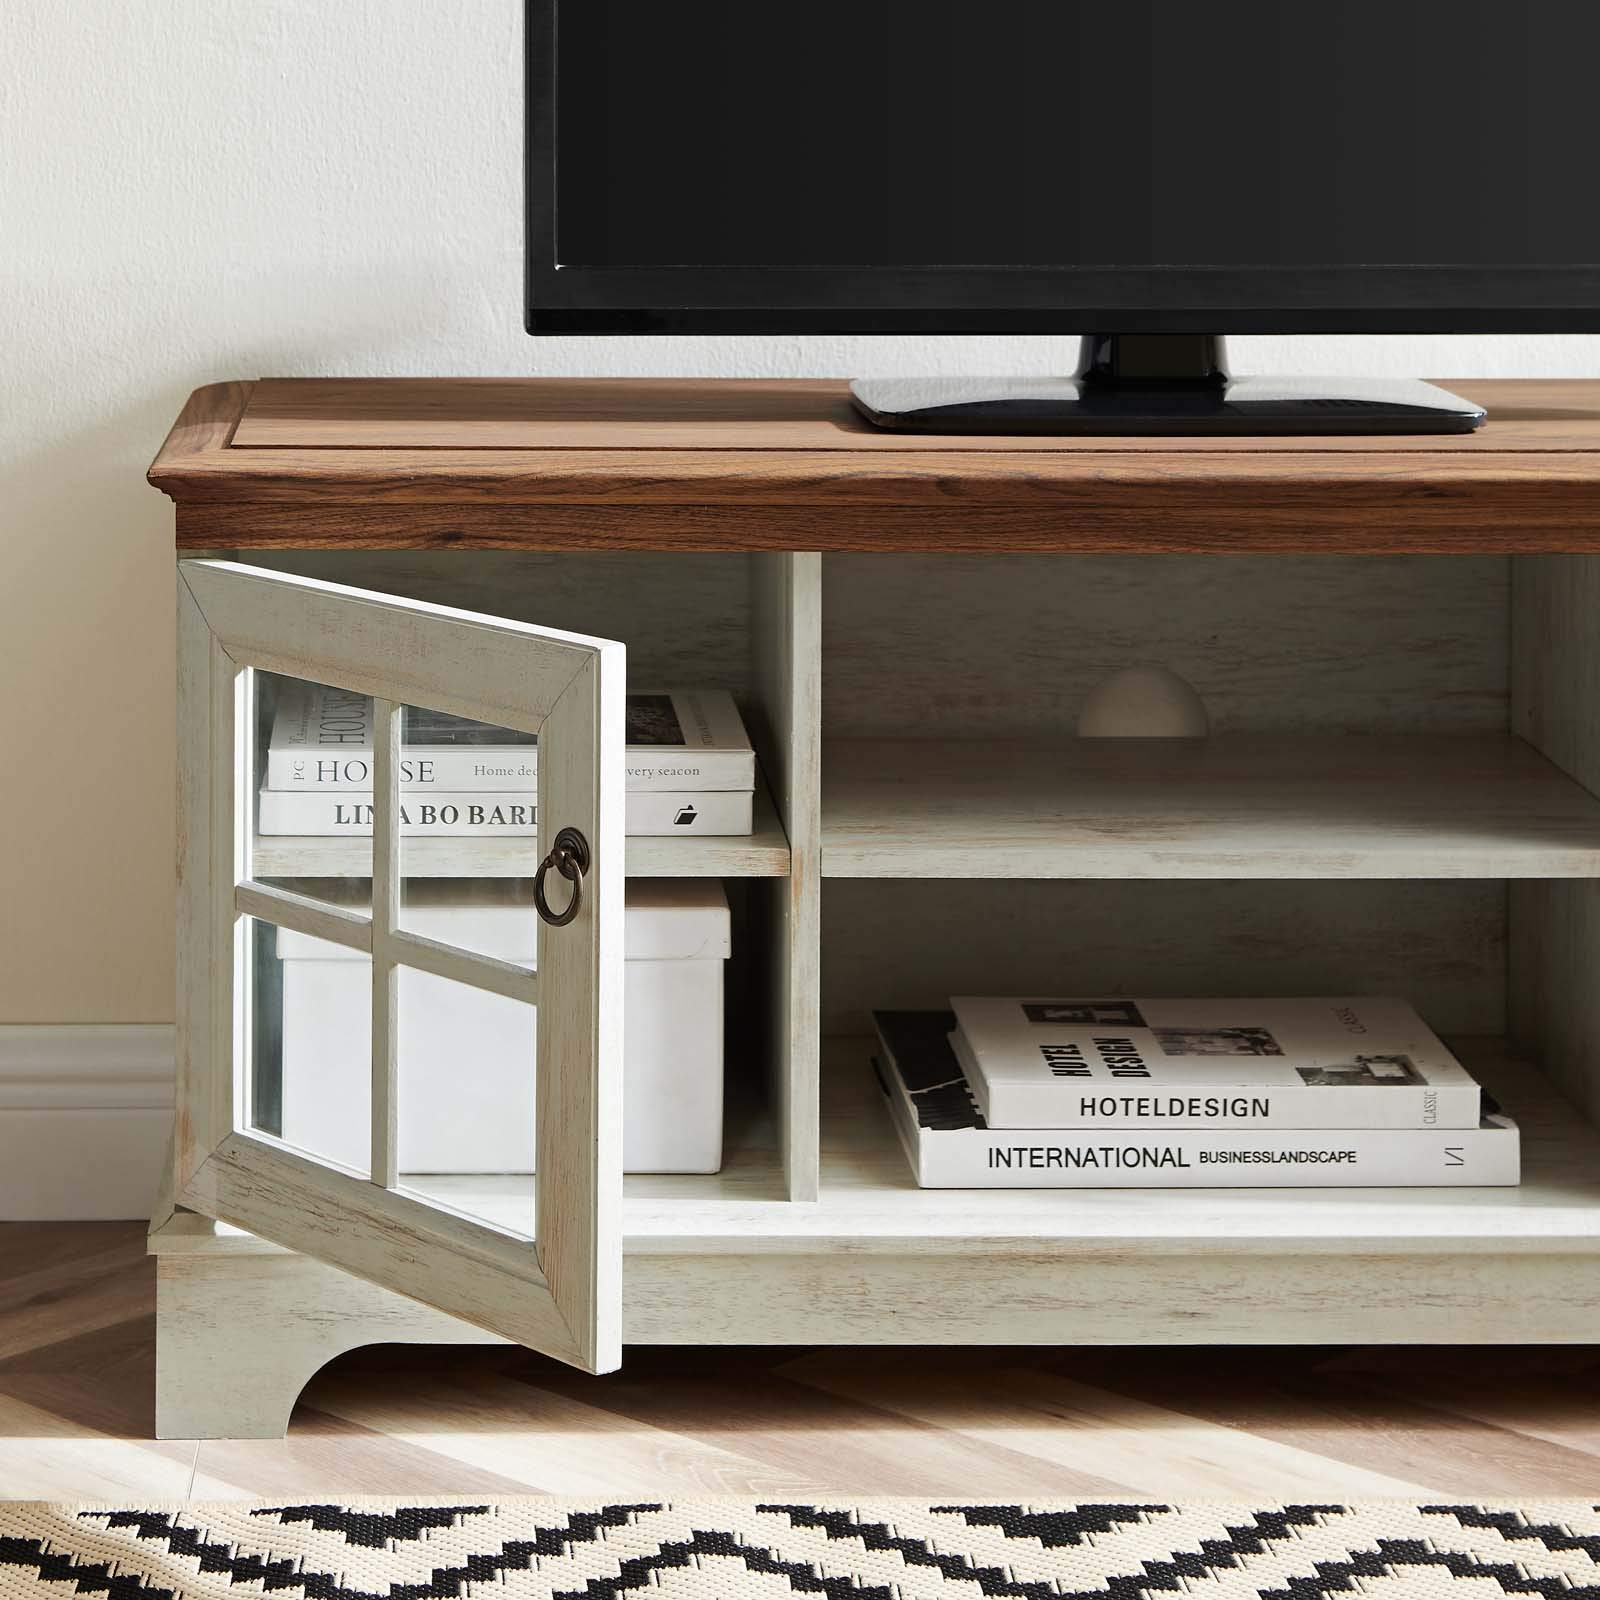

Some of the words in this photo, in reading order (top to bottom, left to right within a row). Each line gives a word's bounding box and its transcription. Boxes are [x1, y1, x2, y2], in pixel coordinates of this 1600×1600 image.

[316, 760, 435, 783] HOSE
[474, 765, 514, 777] Home
[625, 767, 655, 780] very
[419, 804, 459, 825] BO
[1039, 1044, 1093, 1077] HOTEL
[1091, 1038, 1152, 1078] DESIGN
[1080, 1097, 1270, 1117] HOTELDESIGN
[1423, 1090, 1437, 1125] CLASSIC
[987, 1147, 1191, 1168] INTERNATIONAL
[1199, 1151, 1357, 1164] BUSINESSLANDSCAPE
